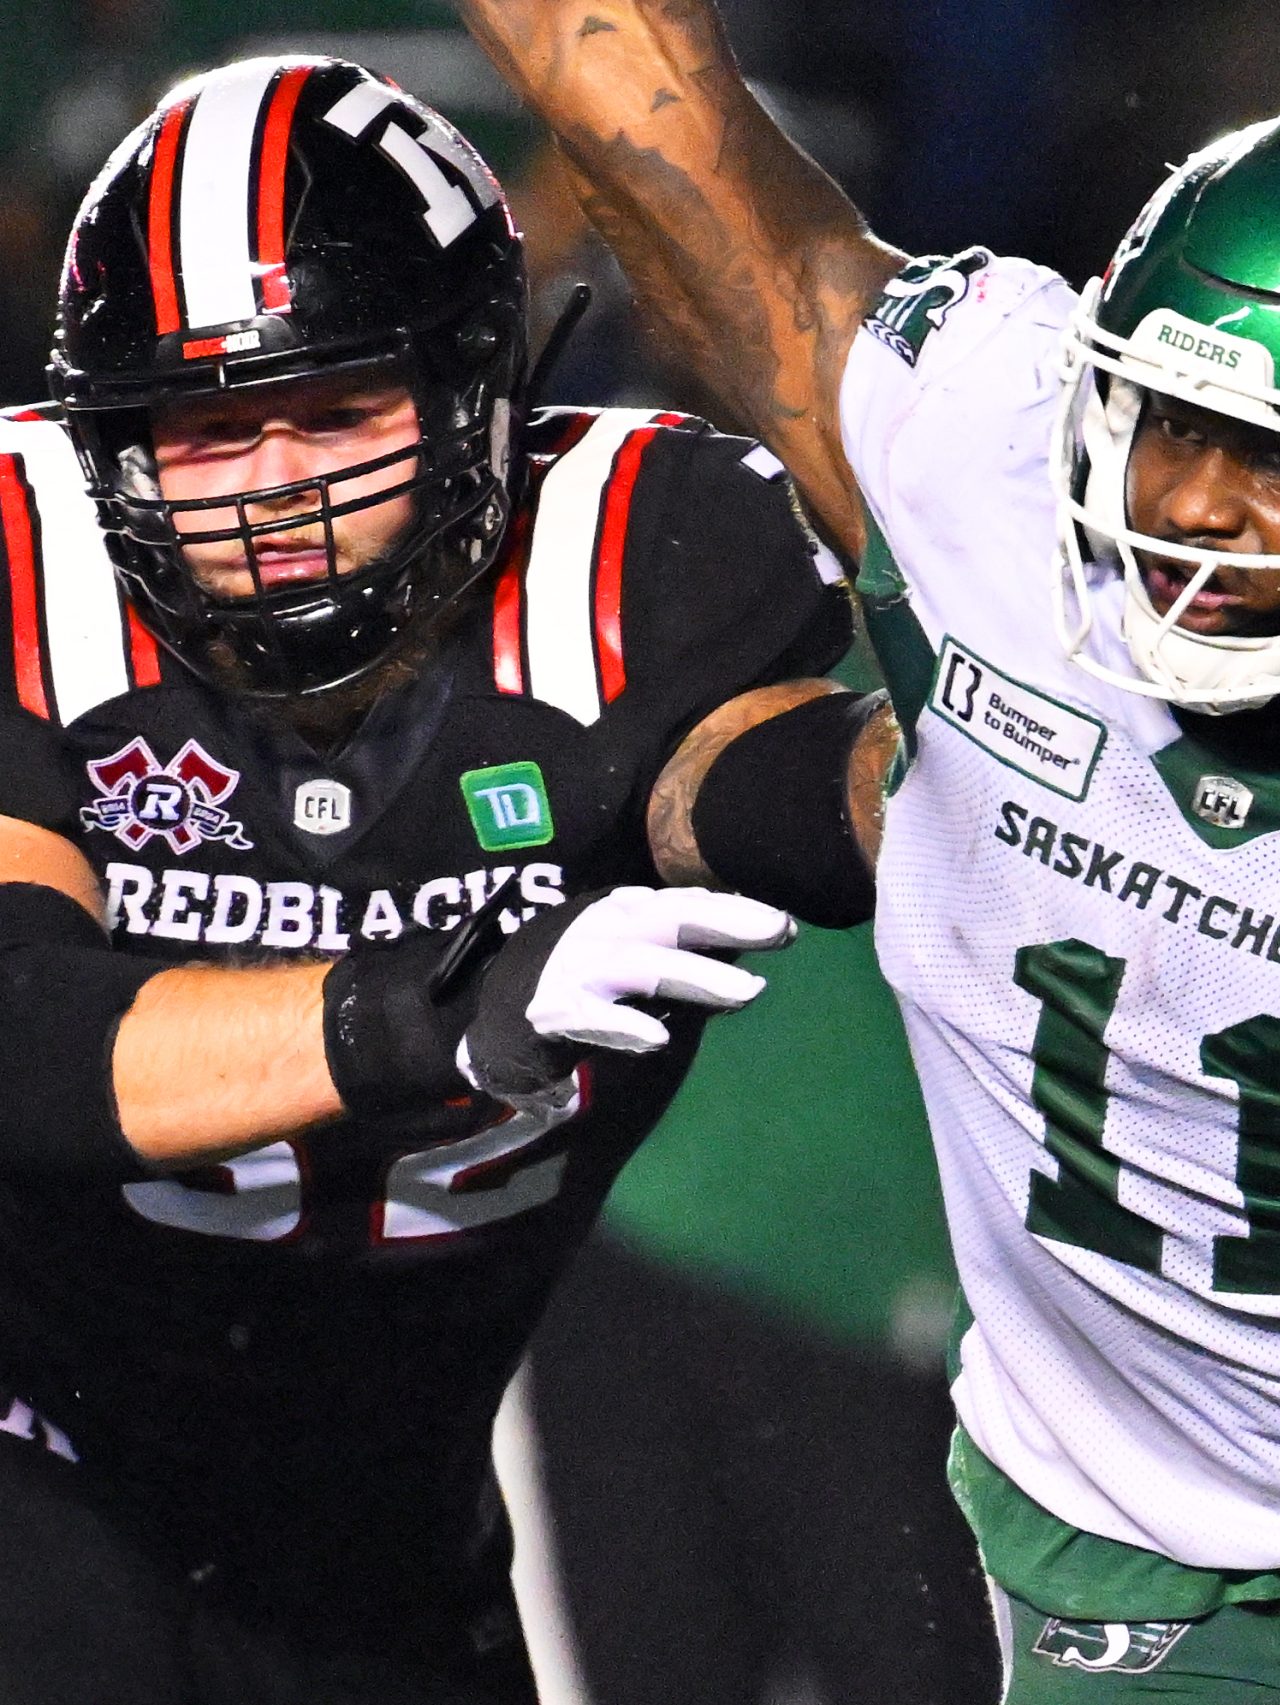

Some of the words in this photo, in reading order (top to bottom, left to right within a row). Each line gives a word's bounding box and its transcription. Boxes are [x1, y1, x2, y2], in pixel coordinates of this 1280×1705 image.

[1157, 324, 1242, 369] RIDERS
[984, 711, 1001, 730] to
[989, 692, 1057, 741] Bumper
[139, 784, 182, 820] R
[304, 796, 341, 820] CFL
[474, 783, 541, 829] TD
[1201, 790, 1239, 820] CFL
